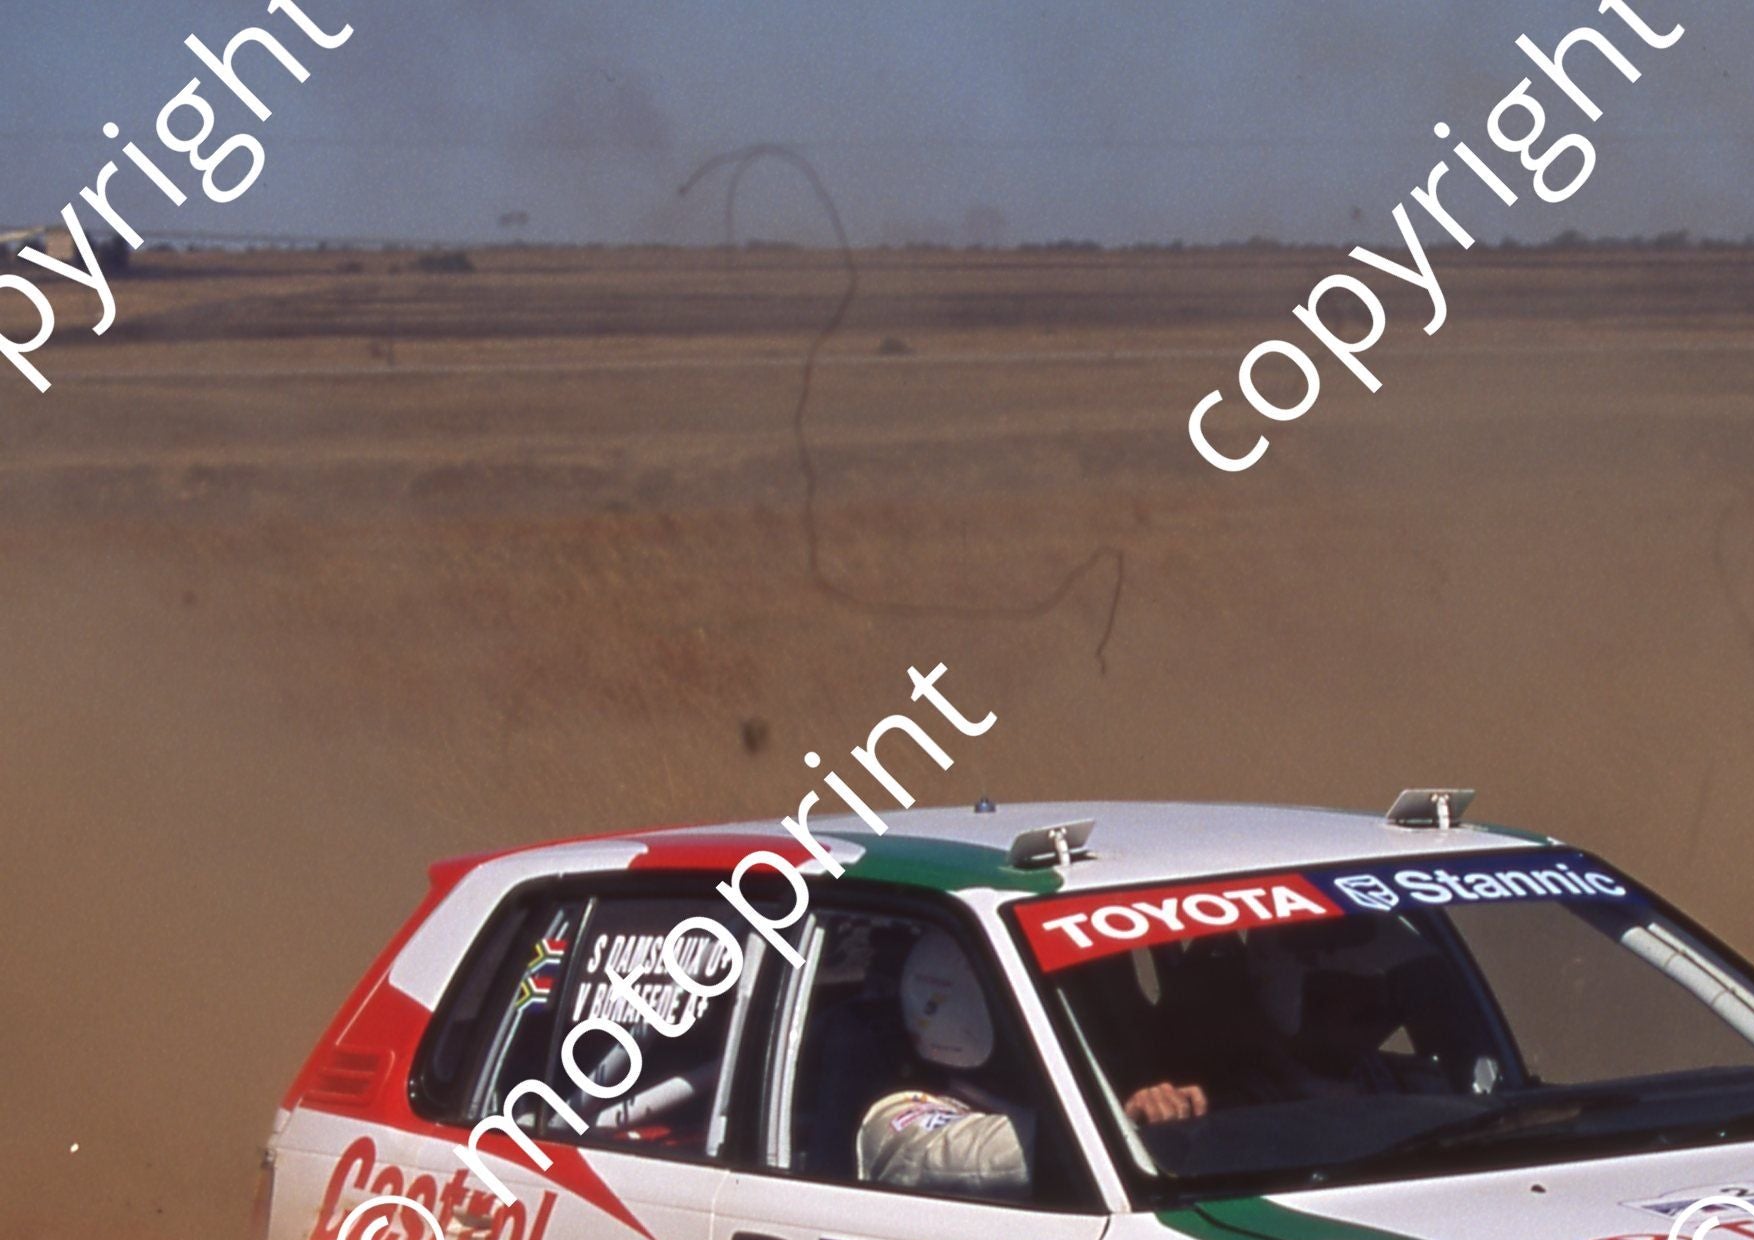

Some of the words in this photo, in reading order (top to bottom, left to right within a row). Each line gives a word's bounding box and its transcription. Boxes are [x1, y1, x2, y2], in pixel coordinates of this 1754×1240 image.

[1394, 864, 1627, 904] Stannic
[1042, 885, 1331, 950] TOYOTA
[586, 934, 608, 973] S
[572, 982, 592, 1022] V
